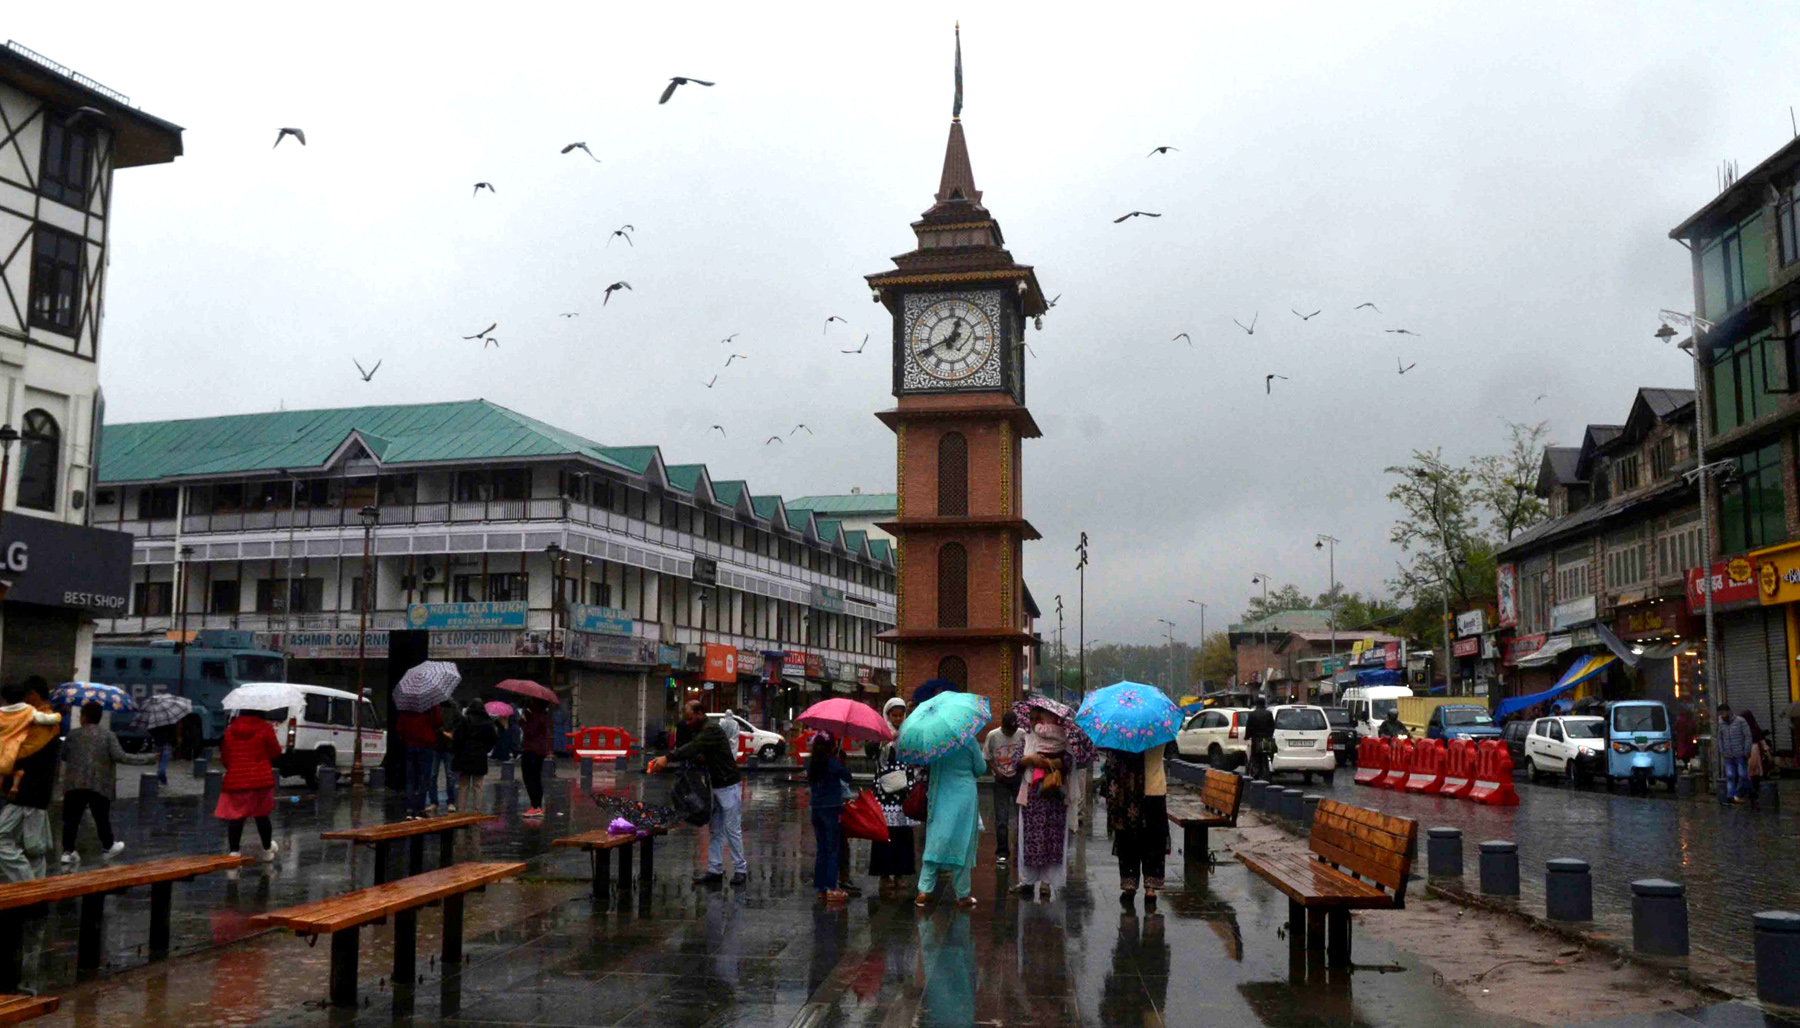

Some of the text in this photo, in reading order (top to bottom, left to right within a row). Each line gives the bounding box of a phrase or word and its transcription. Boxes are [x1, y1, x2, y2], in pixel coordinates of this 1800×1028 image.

[64, 591, 125, 608] BEST SHOP
[462, 602, 489, 614] LALA
[283, 633, 332, 647] ASHMIR
[447, 631, 512, 645] EMPORIUM
